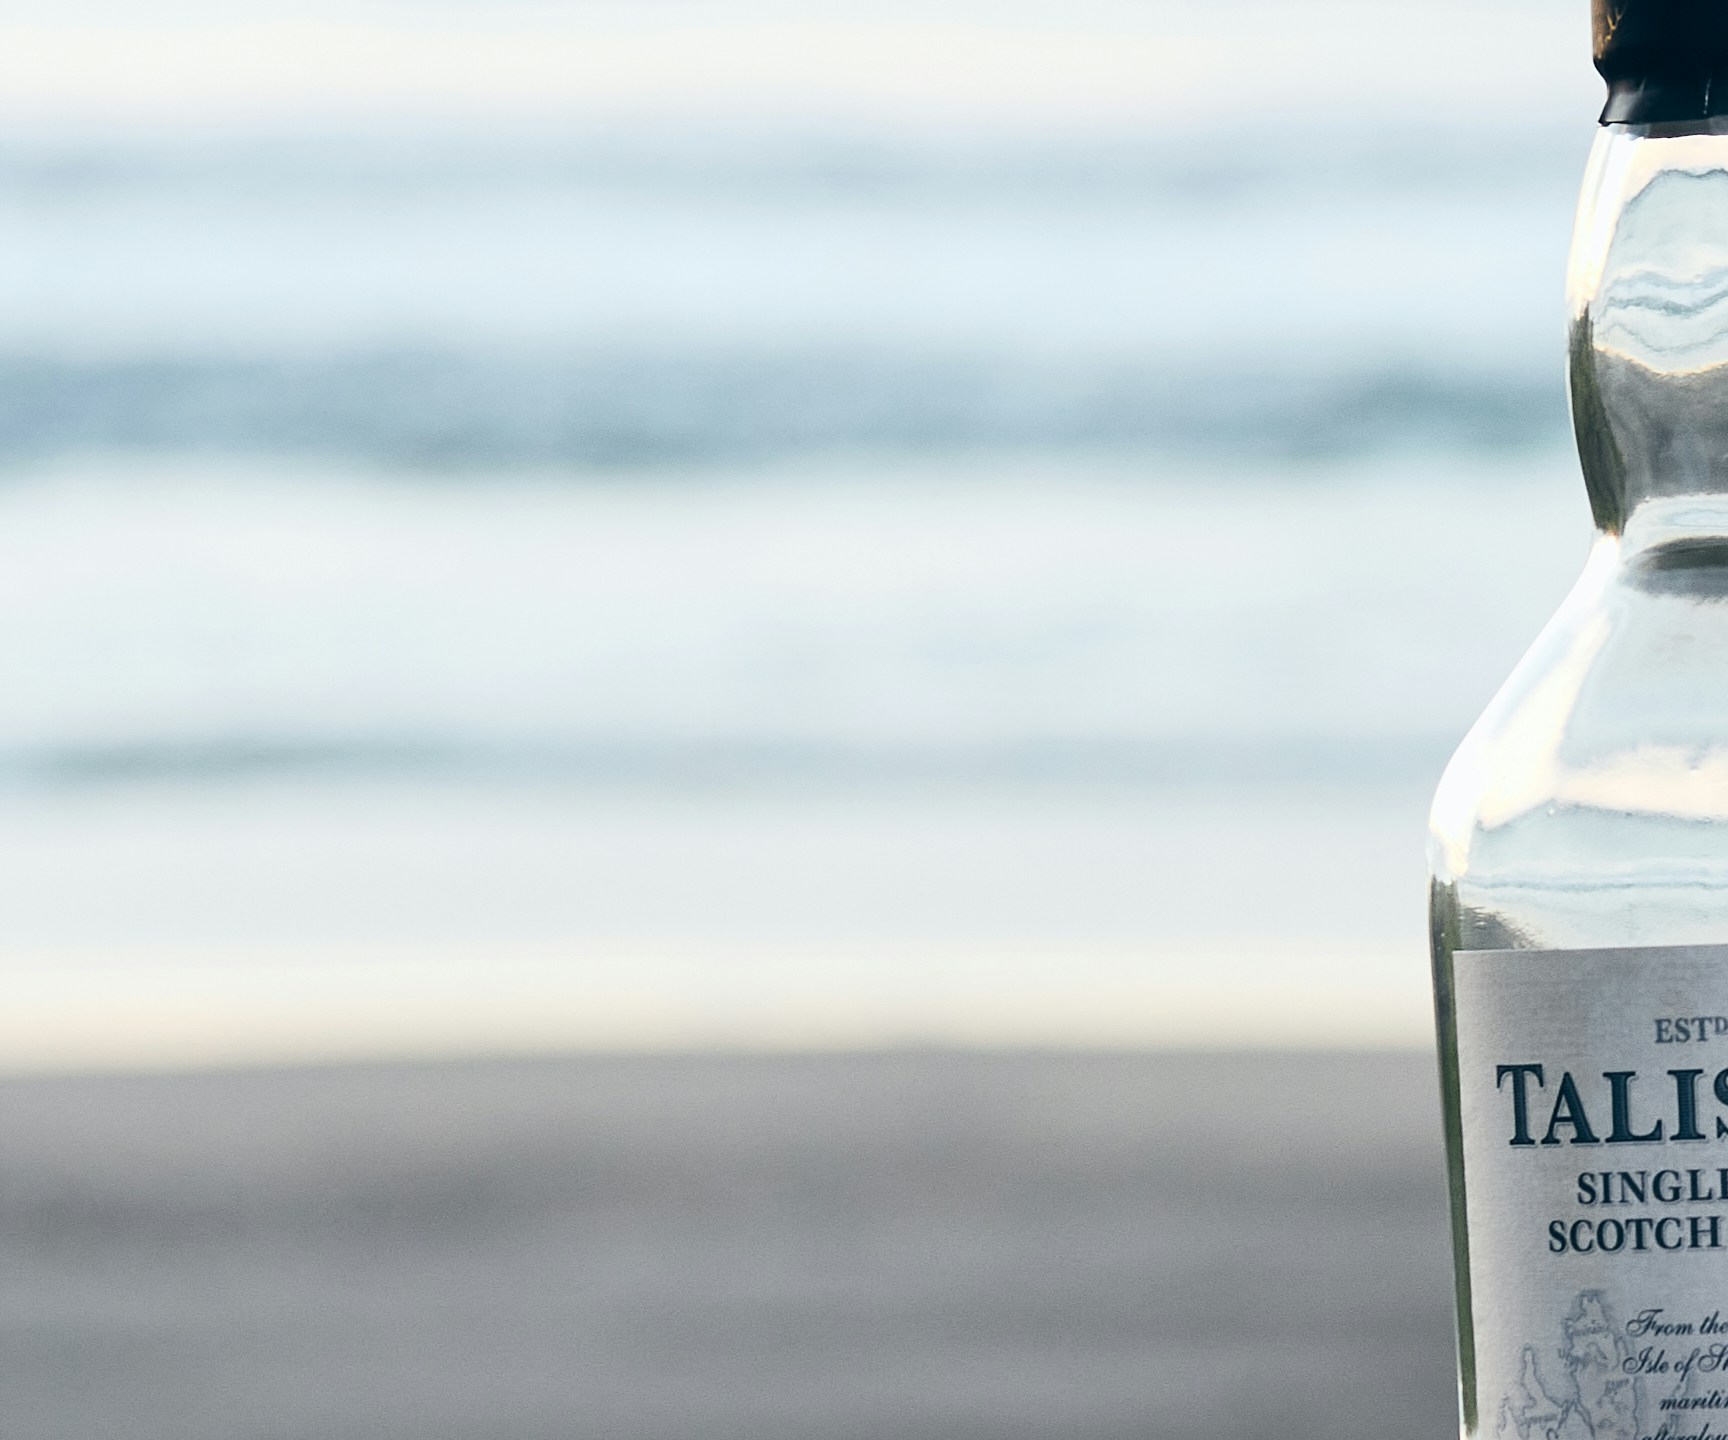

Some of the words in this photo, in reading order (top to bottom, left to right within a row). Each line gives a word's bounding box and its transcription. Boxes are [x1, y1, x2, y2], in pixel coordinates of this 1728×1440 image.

[1548, 1214, 1722, 1254] SCOTCH
[1626, 1308, 1696, 1338] From
[1622, 1346, 1670, 1375] Isle
[1674, 1347, 1698, 1382] of
